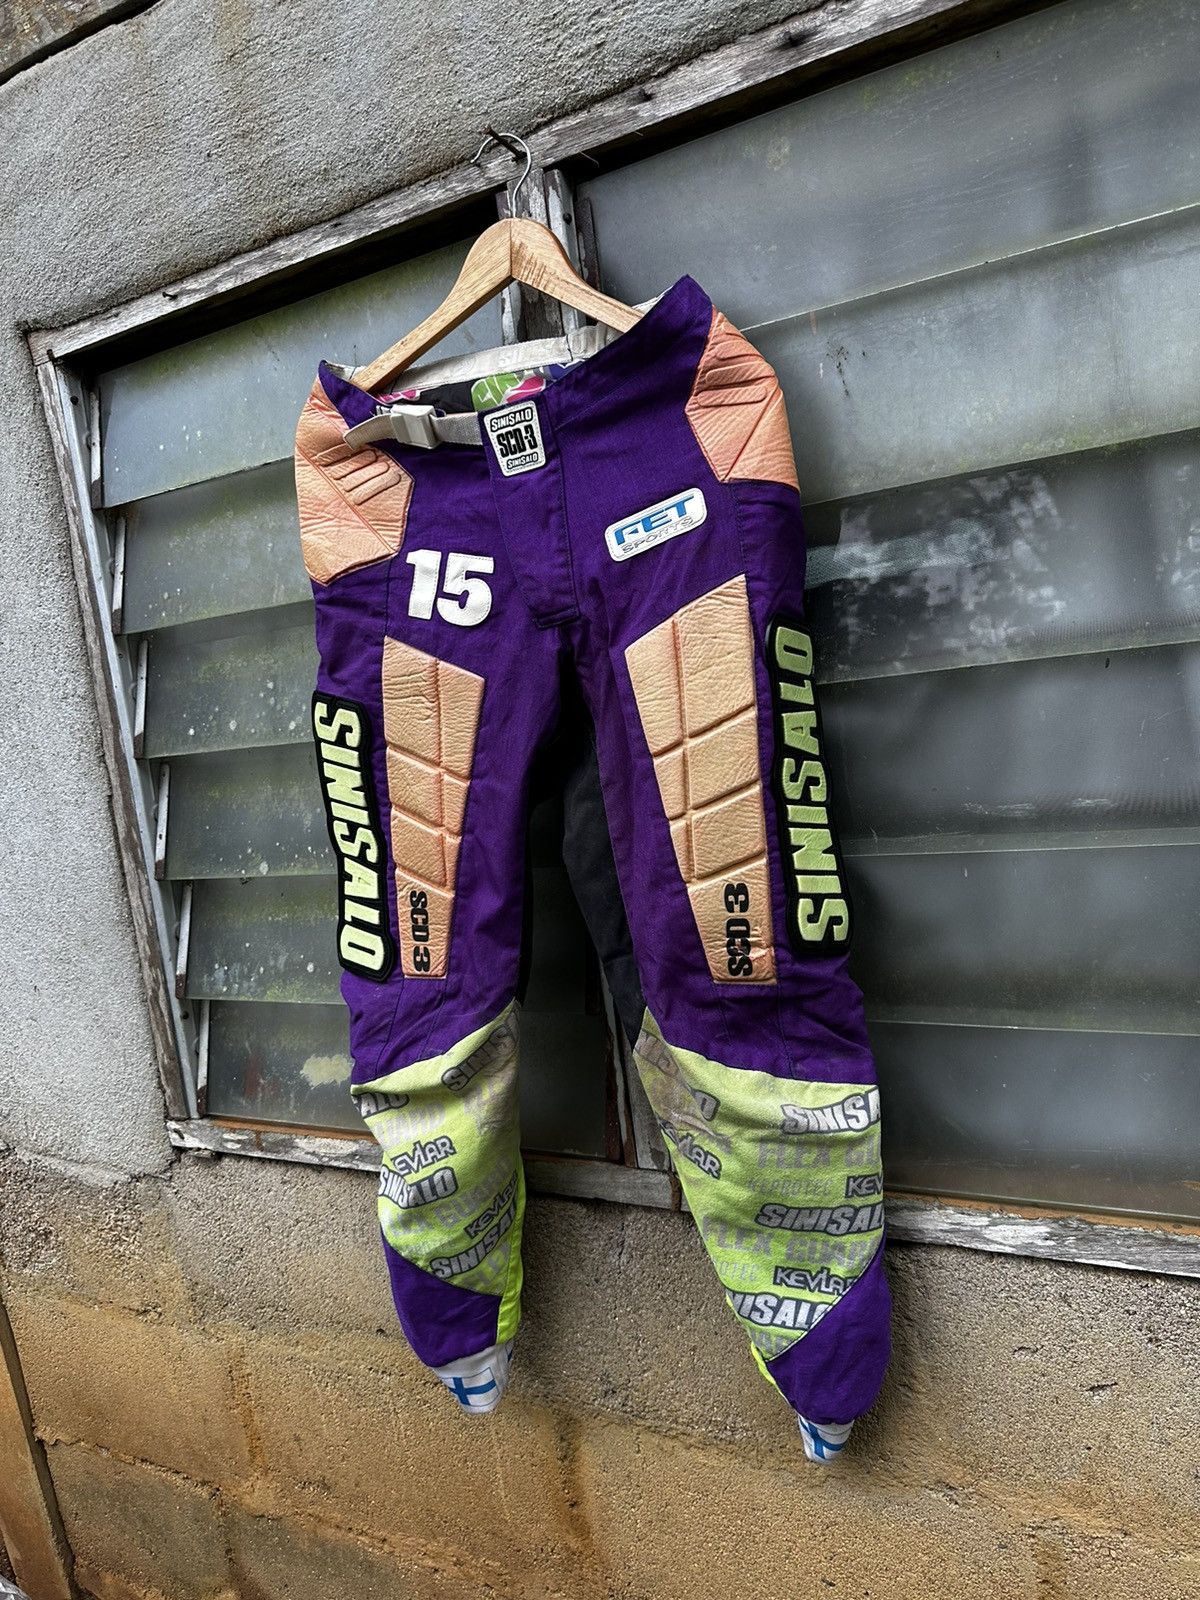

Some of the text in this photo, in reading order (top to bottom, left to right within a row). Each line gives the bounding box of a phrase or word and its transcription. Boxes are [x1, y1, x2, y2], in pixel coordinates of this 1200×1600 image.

[490, 407, 533, 432] SINISALO
[507, 452, 538, 469] SINISALO
[406, 549, 494, 627] 15
[775, 626, 849, 942] SINISALO
[314, 701, 384, 971] SINISALO
[410, 890, 431, 973] SCD 3
[724, 882, 753, 977] SCD 3
[378, 1164, 458, 1209] SINISALO
